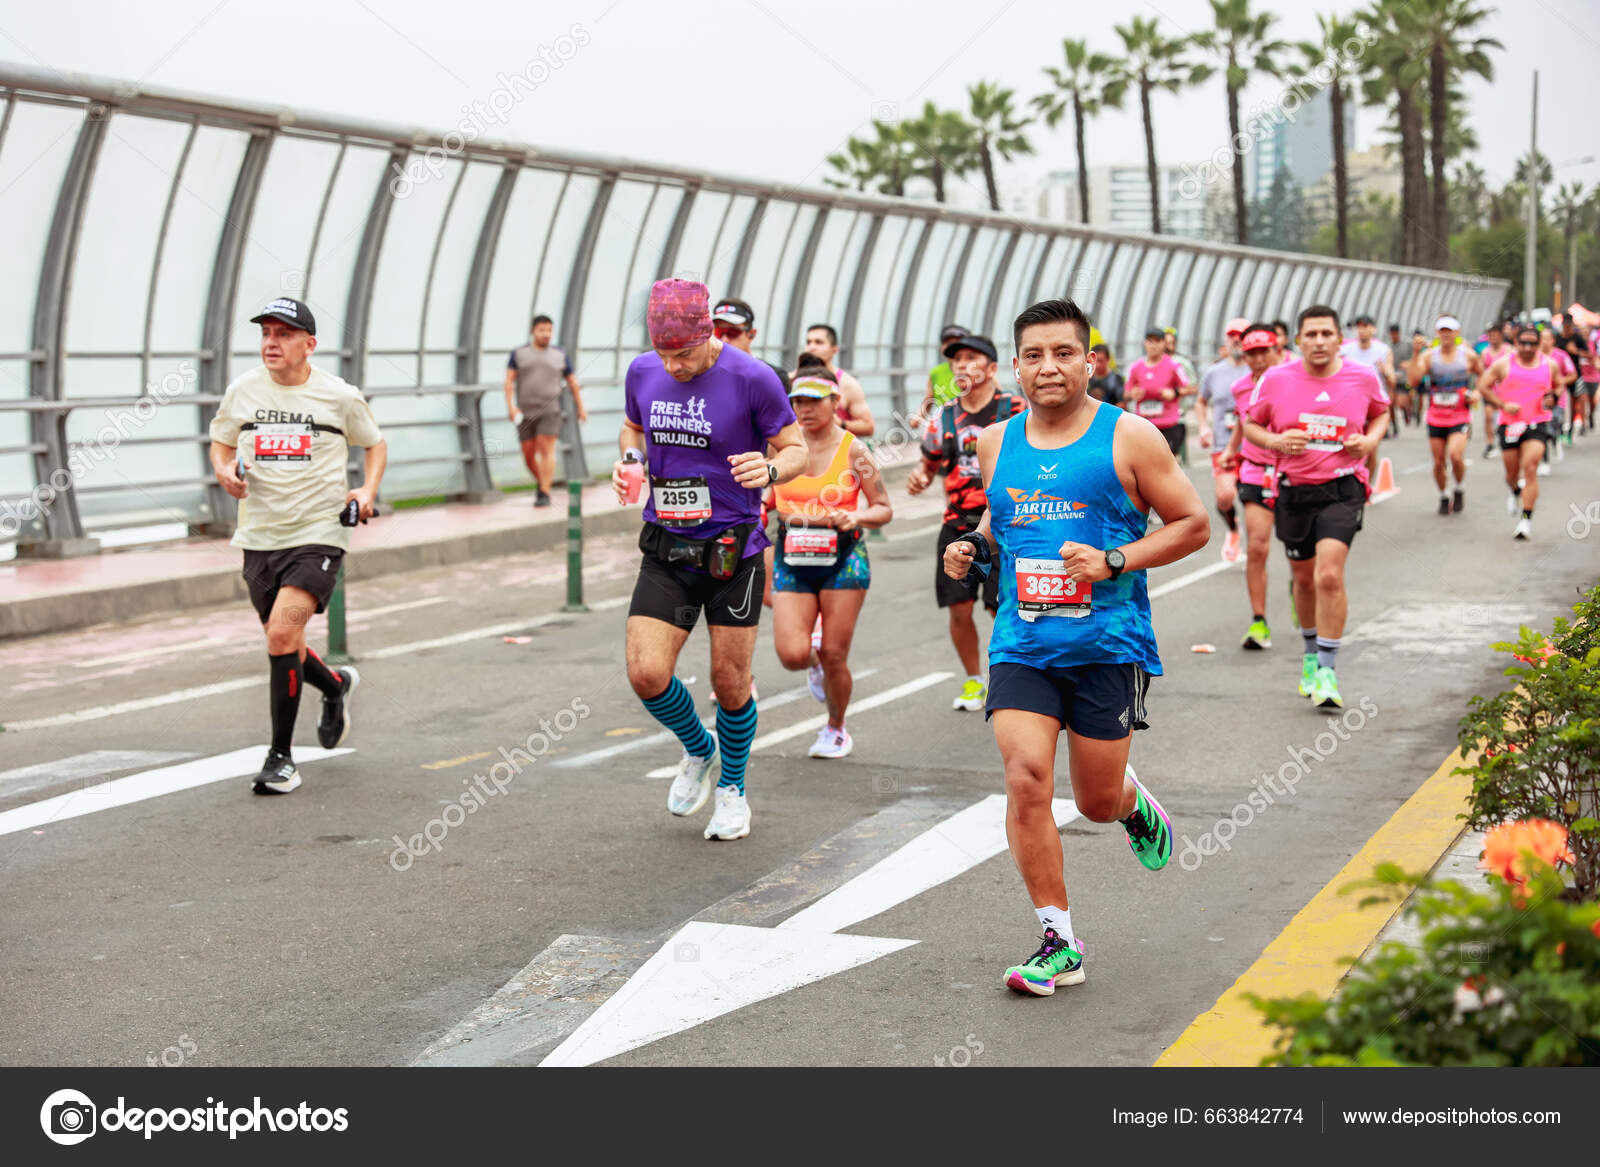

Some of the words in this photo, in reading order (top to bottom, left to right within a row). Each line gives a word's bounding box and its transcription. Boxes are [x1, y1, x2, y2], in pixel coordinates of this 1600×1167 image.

[651, 400, 682, 416] FREE
[255, 409, 315, 424] CREMA
[649, 415, 712, 435] RUNNERS
[652, 431, 708, 448] TRUJILLO
[662, 490, 698, 505] 2359
[1014, 500, 1072, 515] FARTLEK
[1046, 512, 1085, 520] RUNNING
[1026, 575, 1077, 596] 3623
